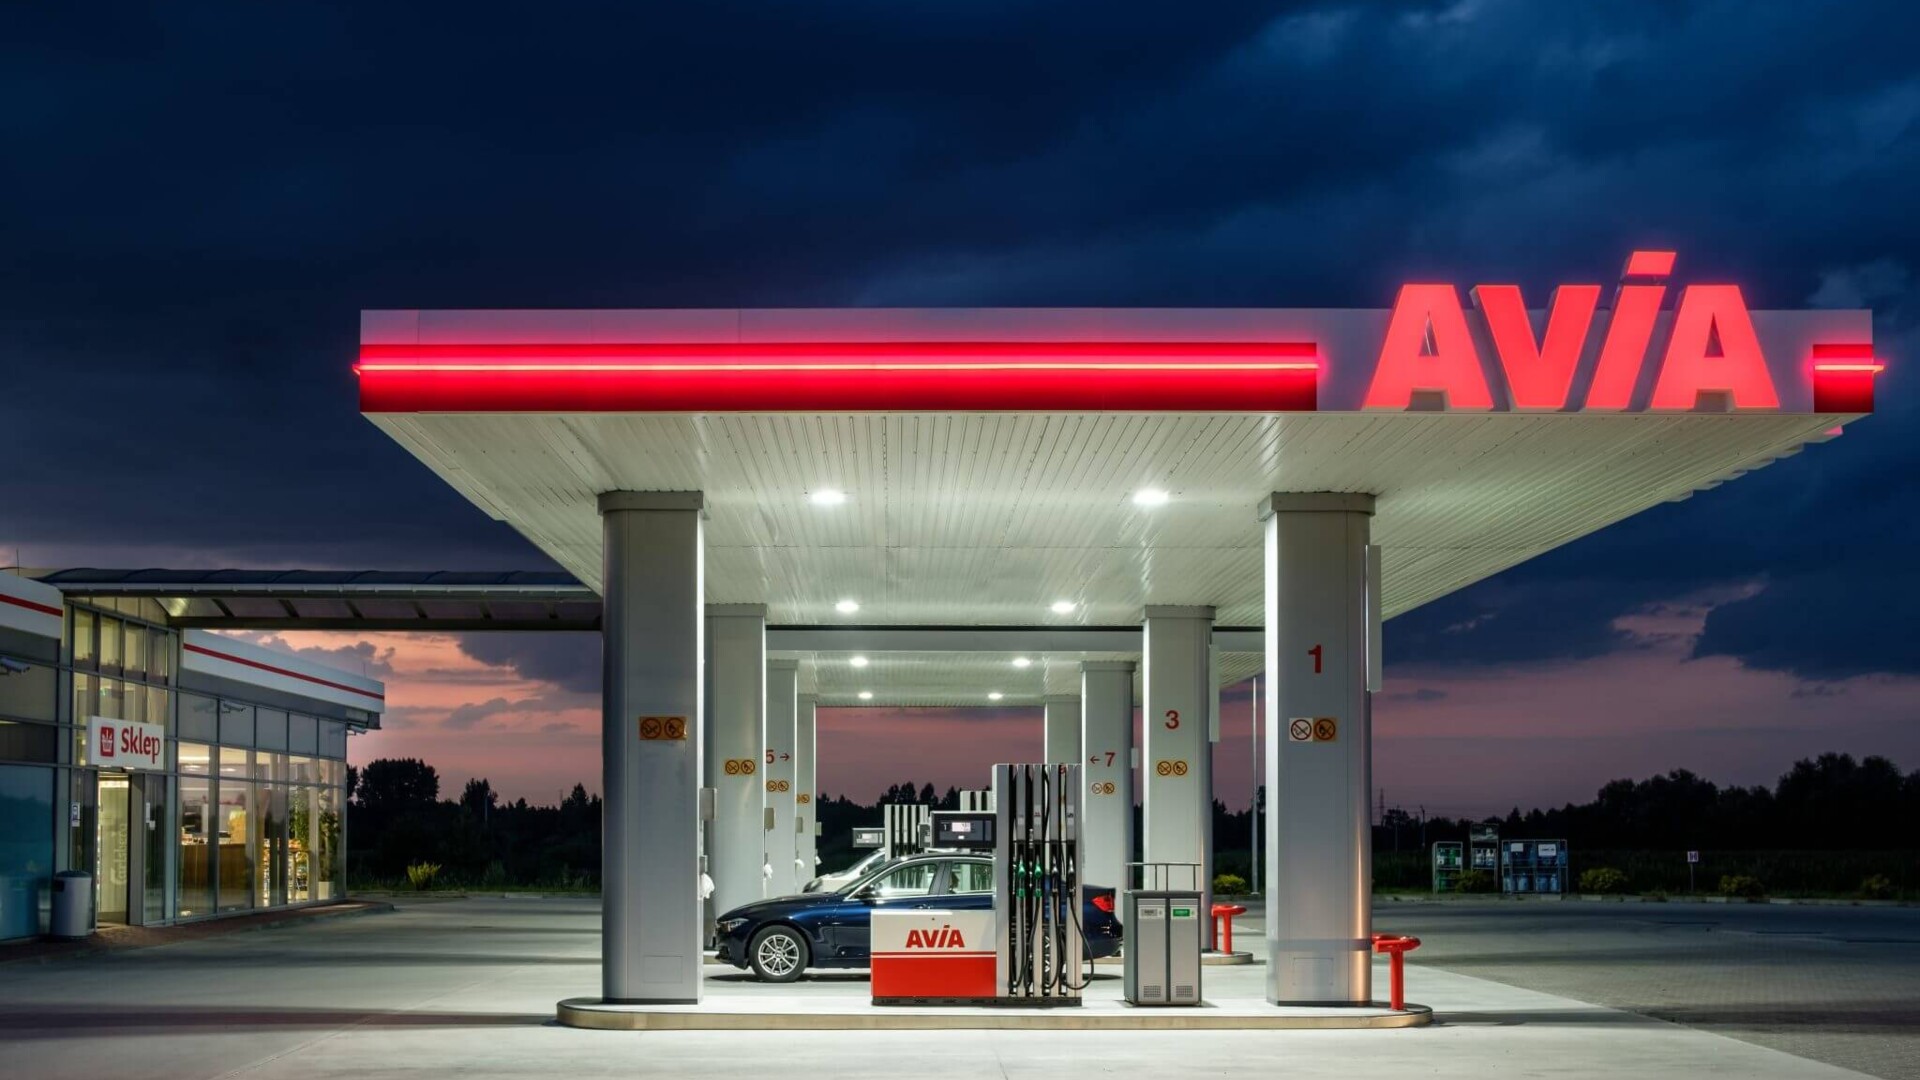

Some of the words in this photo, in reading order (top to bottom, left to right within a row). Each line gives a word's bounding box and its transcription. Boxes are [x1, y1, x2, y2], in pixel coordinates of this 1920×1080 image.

[1308, 645, 1322, 673] 1
[1165, 709, 1180, 730] 3
[121, 726, 160, 764] Sklep
[766, 750, 775, 764] 5
[1104, 751, 1116, 768] 7
